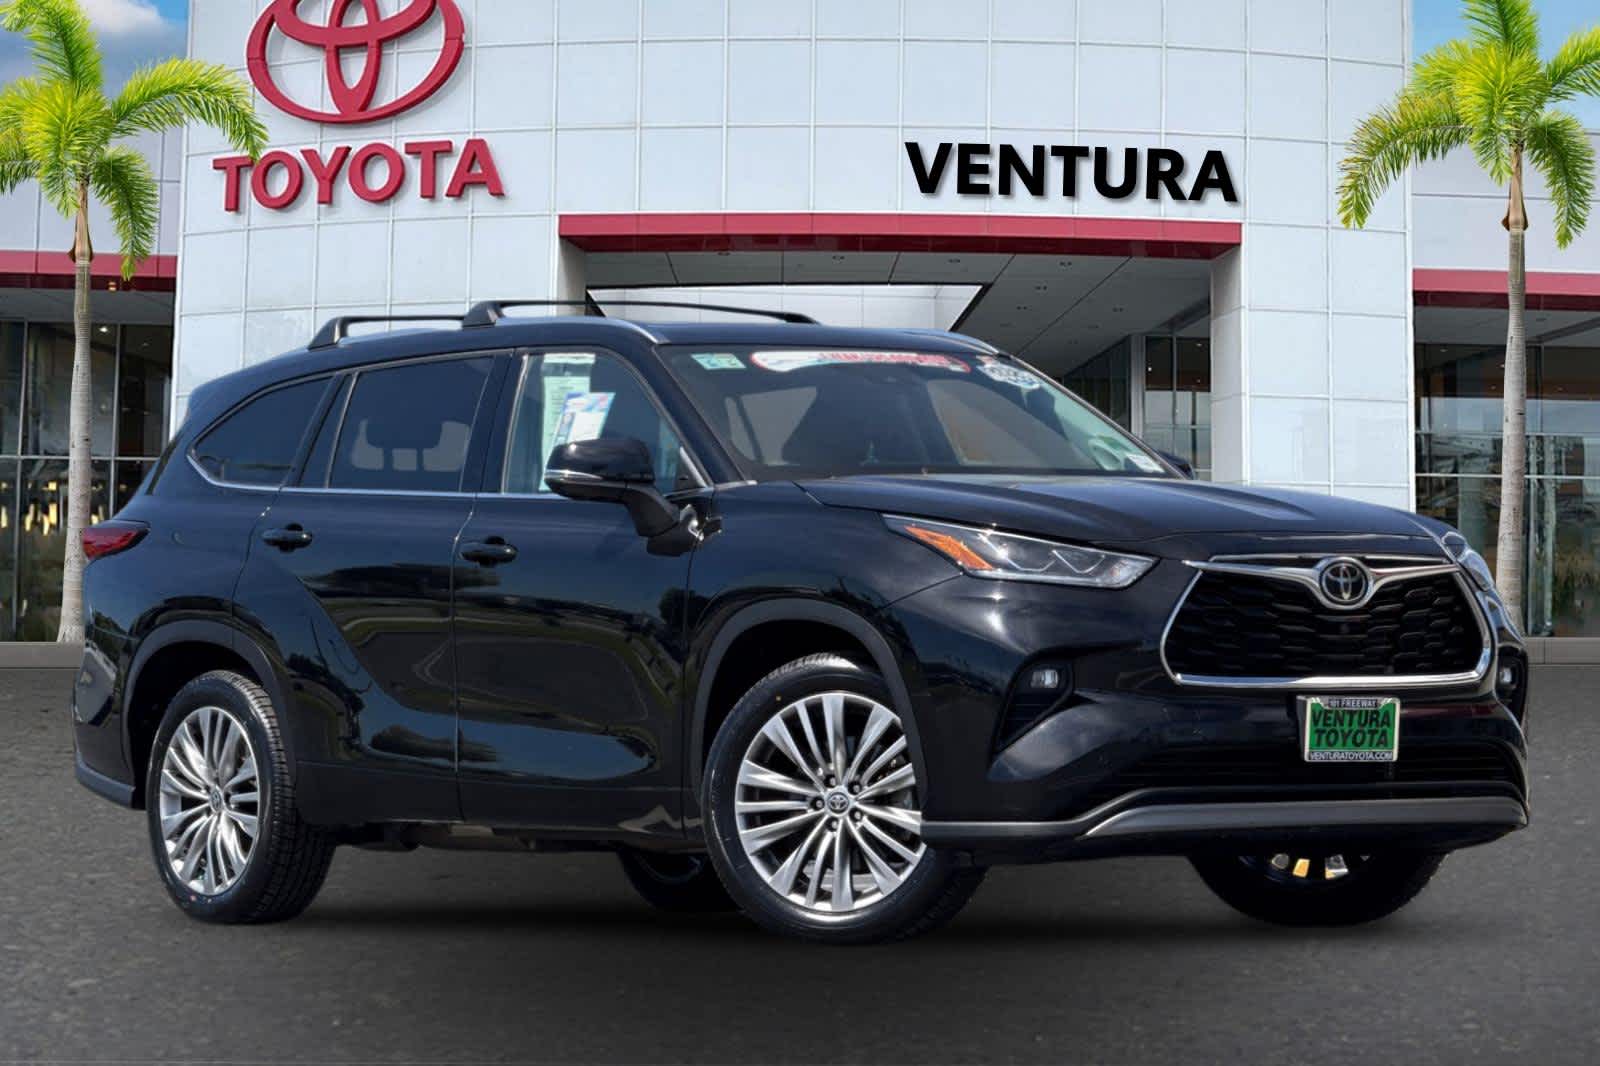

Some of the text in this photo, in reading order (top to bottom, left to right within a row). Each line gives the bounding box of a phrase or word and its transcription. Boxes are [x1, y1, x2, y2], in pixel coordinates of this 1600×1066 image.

[212, 138, 505, 212] TOYOTA
[904, 142, 1239, 202] VENTURA
[1312, 709, 1391, 727] VENTURA
[1314, 728, 1389, 747] TOYOTA
[1310, 751, 1393, 761] VENTURATOYOTA.COM
